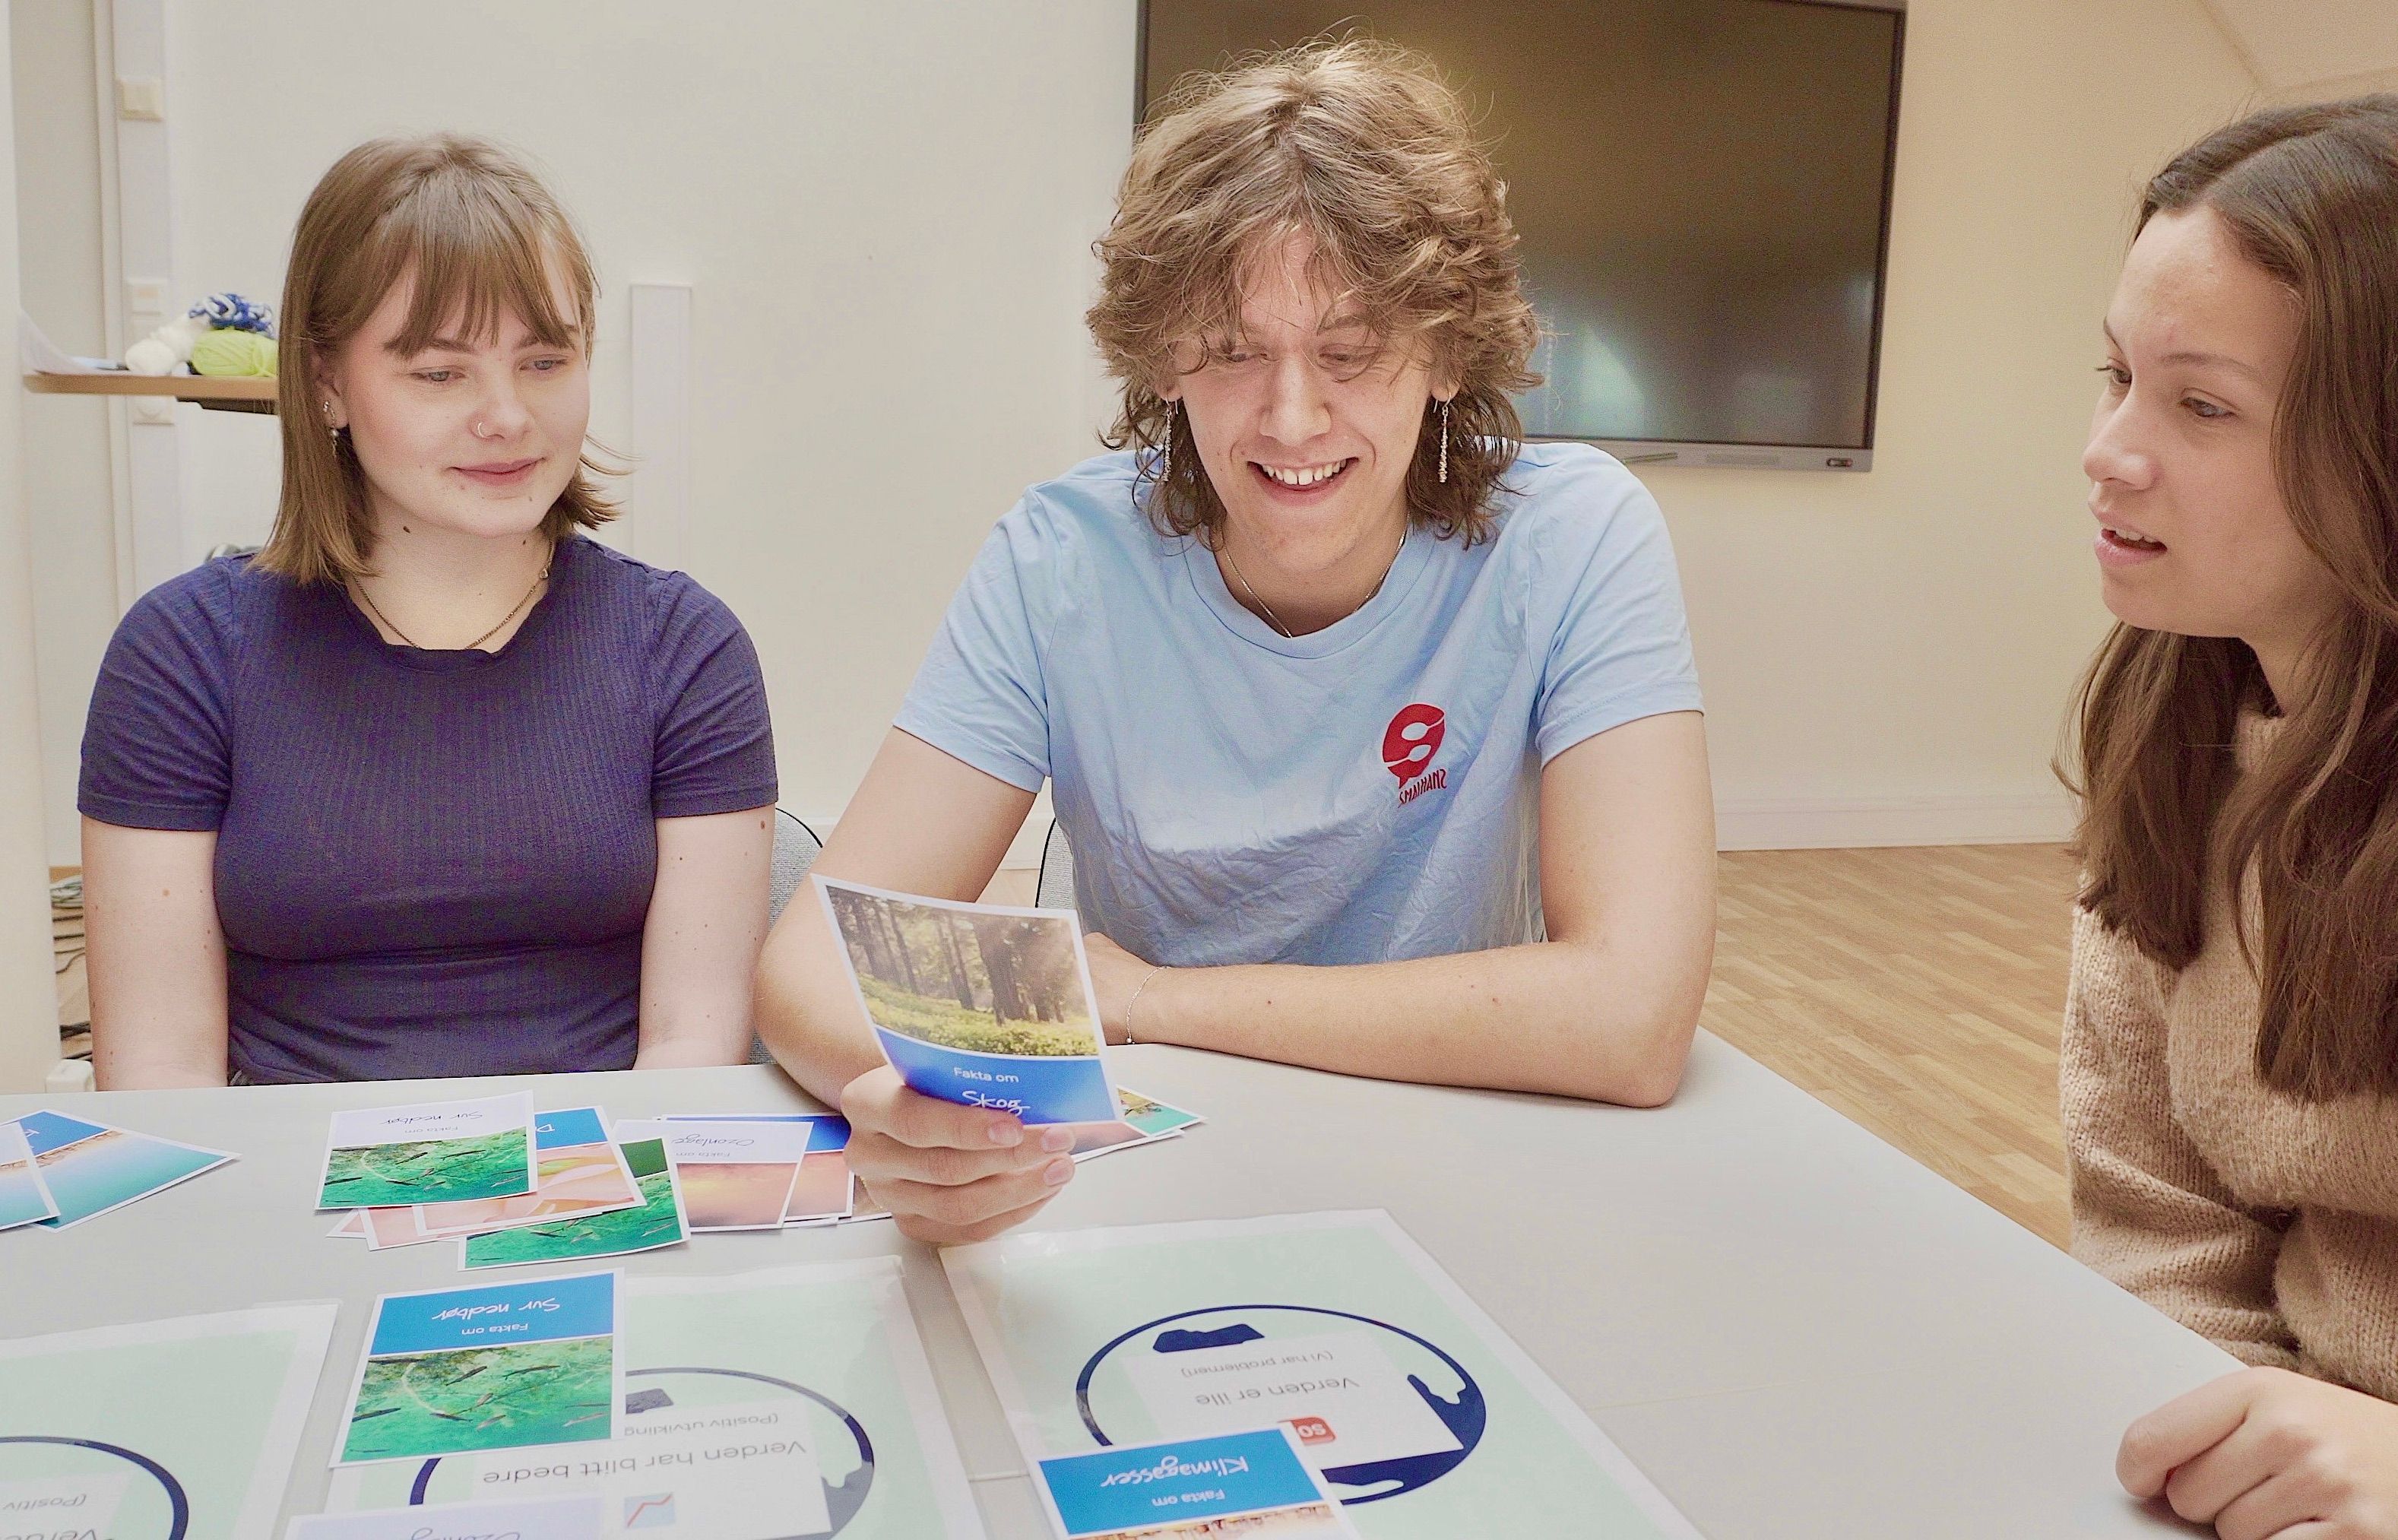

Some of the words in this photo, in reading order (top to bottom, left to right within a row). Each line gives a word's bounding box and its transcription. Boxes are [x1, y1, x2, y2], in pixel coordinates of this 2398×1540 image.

[953, 1066, 992, 1082] Fakta
[996, 1074, 1019, 1082] om
[961, 1090, 1031, 1117] Skog
[450, 1111, 483, 1120] Sur
[535, 1123, 555, 1133] D
[431, 1303, 510, 1320] nedbør
[518, 1298, 560, 1312] Sur
[461, 1327, 485, 1336] om
[489, 1323, 528, 1333] Fakta
[1278, 1354, 1308, 1364] har
[1238, 1388, 1261, 1400] er
[1268, 1377, 1361, 1396] Verden
[1195, 1392, 1230, 1406] ille
[711, 1413, 780, 1428] (Positiv
[1297, 1423, 1327, 1438] SO
[704, 1440, 806, 1460] Verden
[580, 1457, 636, 1475] blitt
[646, 1450, 693, 1468] har
[483, 1464, 569, 1484] bedre
[1100, 1455, 1249, 1488] Klimagasser
[1151, 1495, 1178, 1507] om
[1181, 1488, 1226, 1503] Fakta
